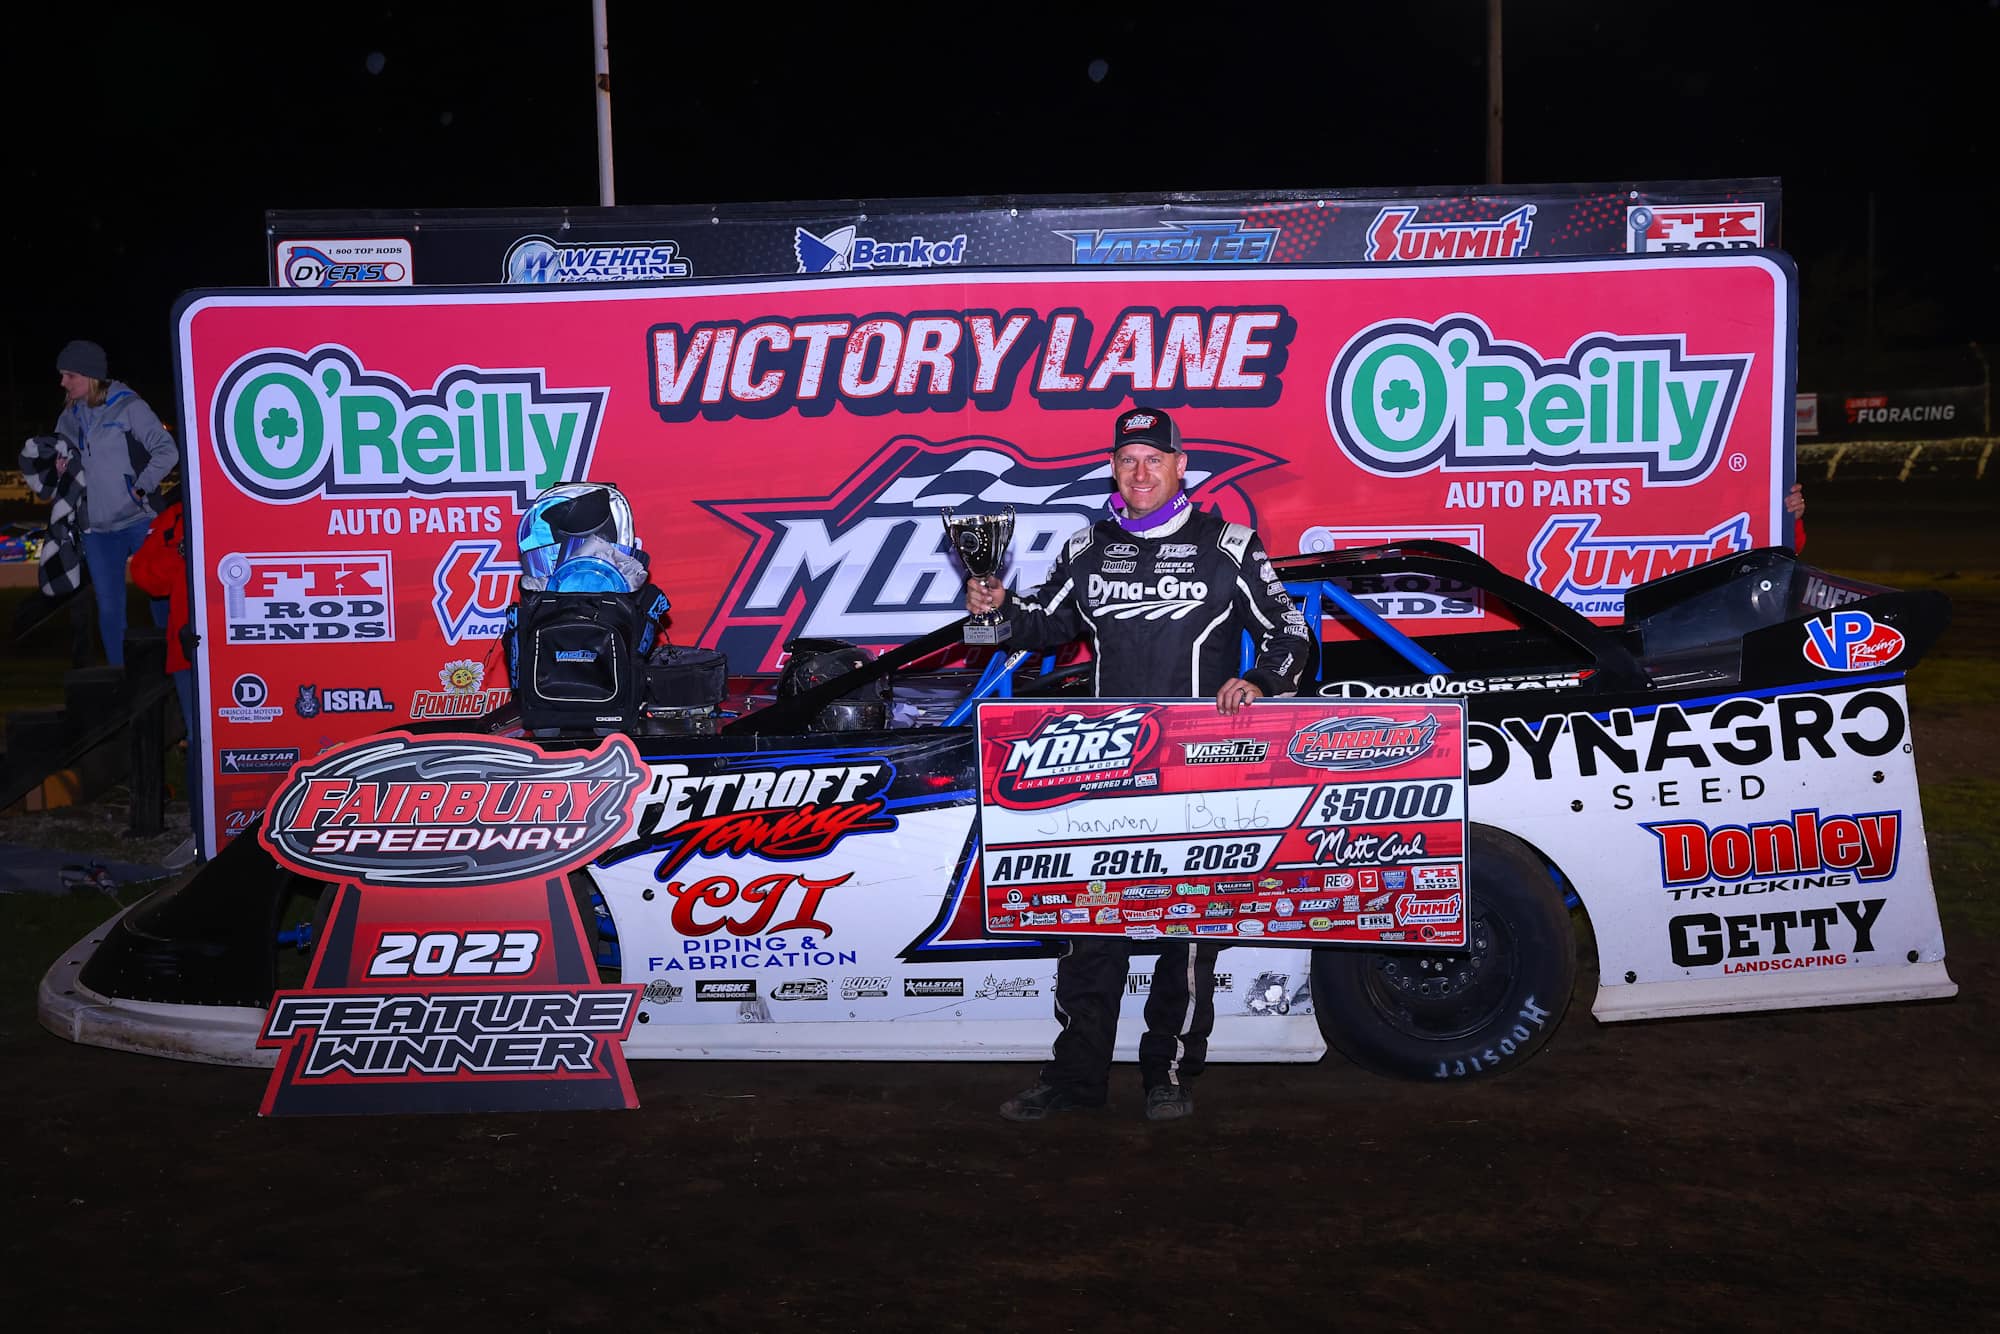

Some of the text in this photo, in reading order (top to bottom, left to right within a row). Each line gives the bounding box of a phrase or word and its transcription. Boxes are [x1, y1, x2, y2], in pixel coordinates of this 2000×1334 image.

[1646, 211, 1757, 239] FK
[561, 247, 674, 267] WEHRS
[853, 235, 967, 265] Bank of
[294, 264, 383, 281] DYER'S
[554, 265, 688, 277] MACHINE
[652, 311, 1282, 406] VICTORY LANE
[1352, 338, 1720, 462] O'Reilly
[1857, 405, 1956, 424] FLORACING
[233, 368, 580, 490] O'Reilly
[1445, 478, 1631, 509] AUTO PARTS
[327, 506, 502, 536] AUTO PARTS
[245, 562, 384, 599] FK
[745, 514, 1096, 638] MAR
[1087, 573, 1209, 605] Dyna-Gro
[264, 600, 385, 620] ROD
[1566, 601, 1625, 613] RACING
[230, 621, 387, 642] ENDS
[1803, 610, 1875, 671] VP
[1851, 639, 1902, 664] Racing
[241, 684, 263, 703] D
[1319, 674, 1486, 700] Douglas
[1488, 678, 1580, 692] RAM
[413, 693, 484, 715] PONTIAC
[1004, 725, 1140, 779] MARS
[1294, 725, 1431, 754] FAIRBURY
[1467, 690, 1907, 787] DYNAGRO
[237, 752, 294, 761] ALLSTAR
[1051, 760, 1127, 774] LATE MODEL
[1303, 745, 1422, 763] SPEEDWAY
[1016, 769, 1130, 790] CHAMPIONSHIP
[1080, 778, 1134, 792] POWERED BY
[1612, 774, 1766, 810] SEED
[284, 777, 620, 833] FAIRBURY
[625, 764, 882, 838] PETROFF
[1319, 783, 1455, 823] $5000
[312, 826, 590, 854] SPEEDWAY
[661, 802, 892, 876] Towing
[1646, 809, 1901, 884] Donley
[991, 842, 1262, 882] APRIL 29th, 2023
[1418, 868, 1457, 879] FK
[1666, 874, 1853, 901] TRUCKING
[683, 935, 819, 954] PIPING &
[1668, 898, 1888, 968] GETTY
[368, 931, 541, 977] 2023
[649, 950, 857, 971] FABRICATION
[1723, 953, 1848, 975] LANDSCAPING
[701, 983, 751, 993] PENSKE
[840, 976, 892, 990] BUDDA
[267, 992, 634, 1038] FEATURE
[304, 1032, 595, 1075] WINNER
